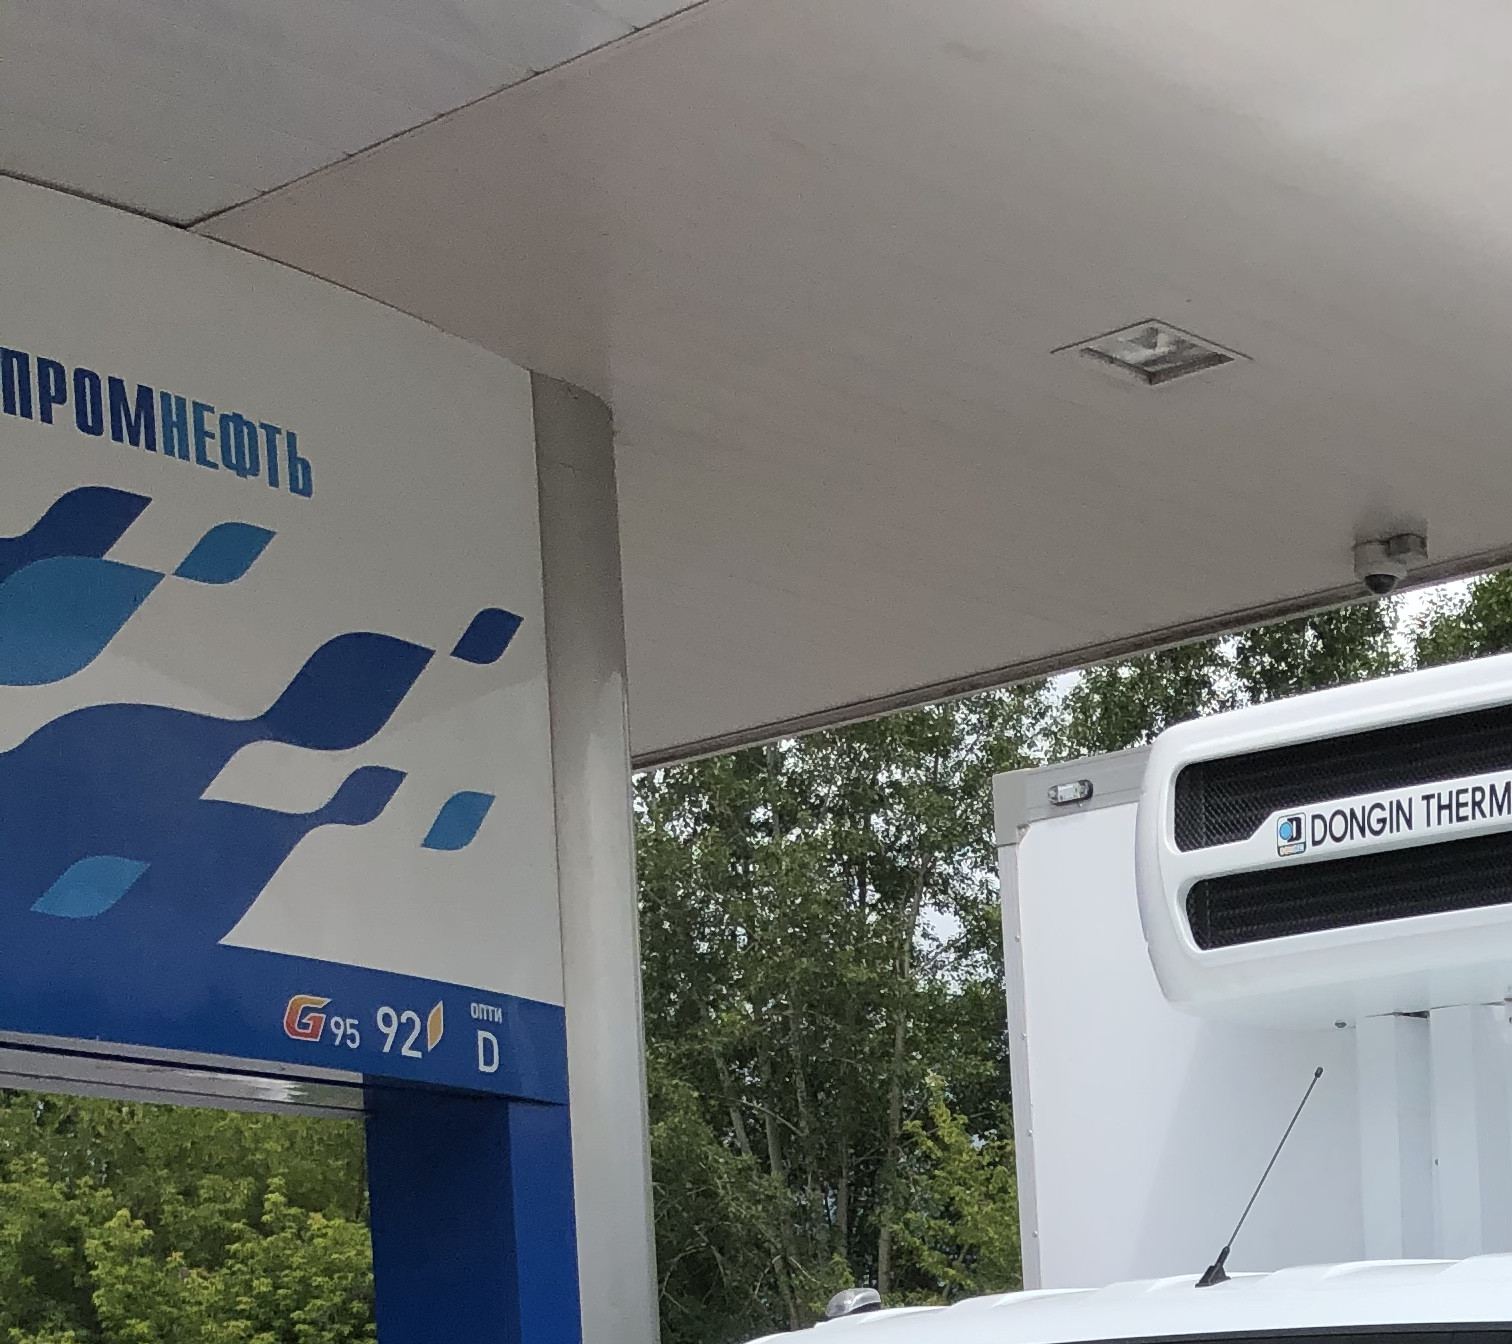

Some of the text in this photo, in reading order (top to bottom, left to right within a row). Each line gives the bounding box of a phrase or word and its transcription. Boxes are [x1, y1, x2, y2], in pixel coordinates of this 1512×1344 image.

[0, 346, 314, 499] ПРОМНЕФТЬ
[1310, 797, 1413, 847] DONGIN
[330, 1016, 361, 1049] 95
[376, 1006, 423, 1059] 92
[470, 1002, 503, 1024] ОПТИ
[477, 1029, 500, 1073] D
